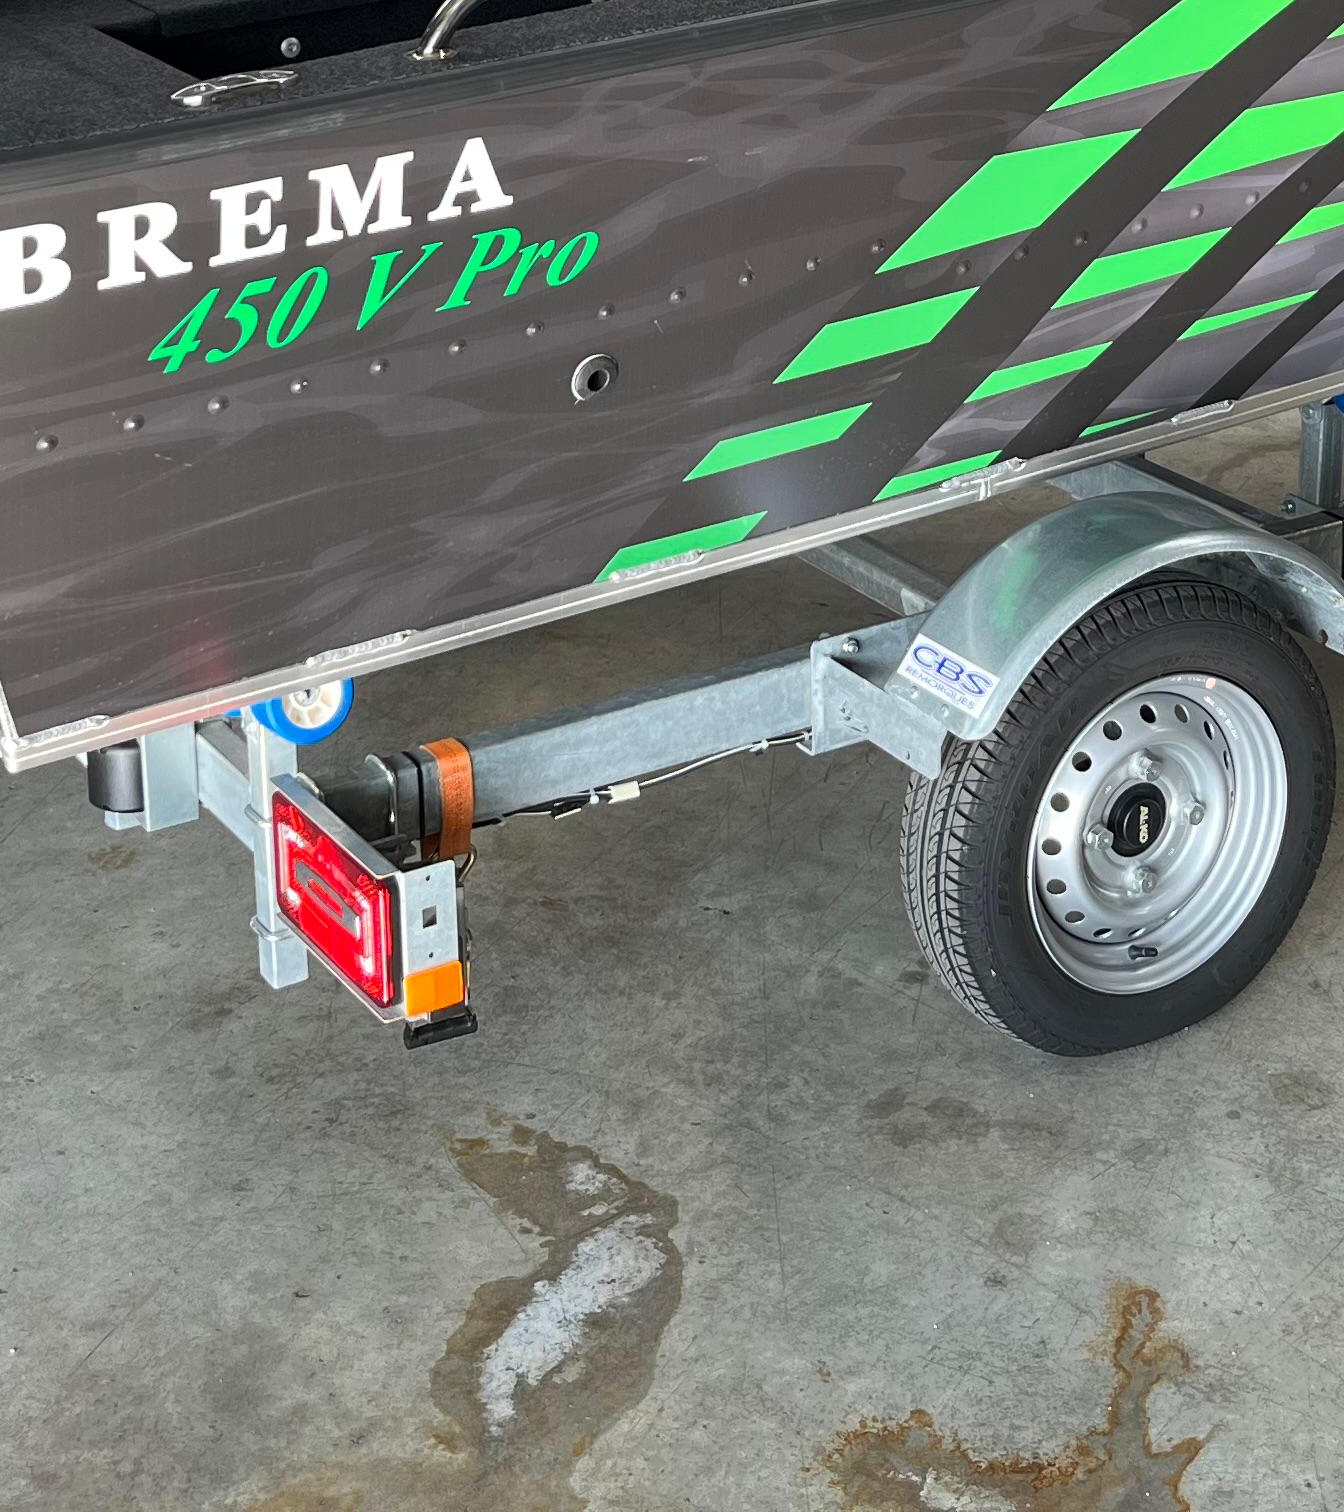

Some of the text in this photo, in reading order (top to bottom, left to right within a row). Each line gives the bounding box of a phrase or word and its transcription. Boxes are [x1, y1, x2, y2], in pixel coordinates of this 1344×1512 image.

[146, 225, 600, 375] 450 V Pro
[905, 666, 976, 709] REMORQUES
[912, 644, 993, 697] CBS
